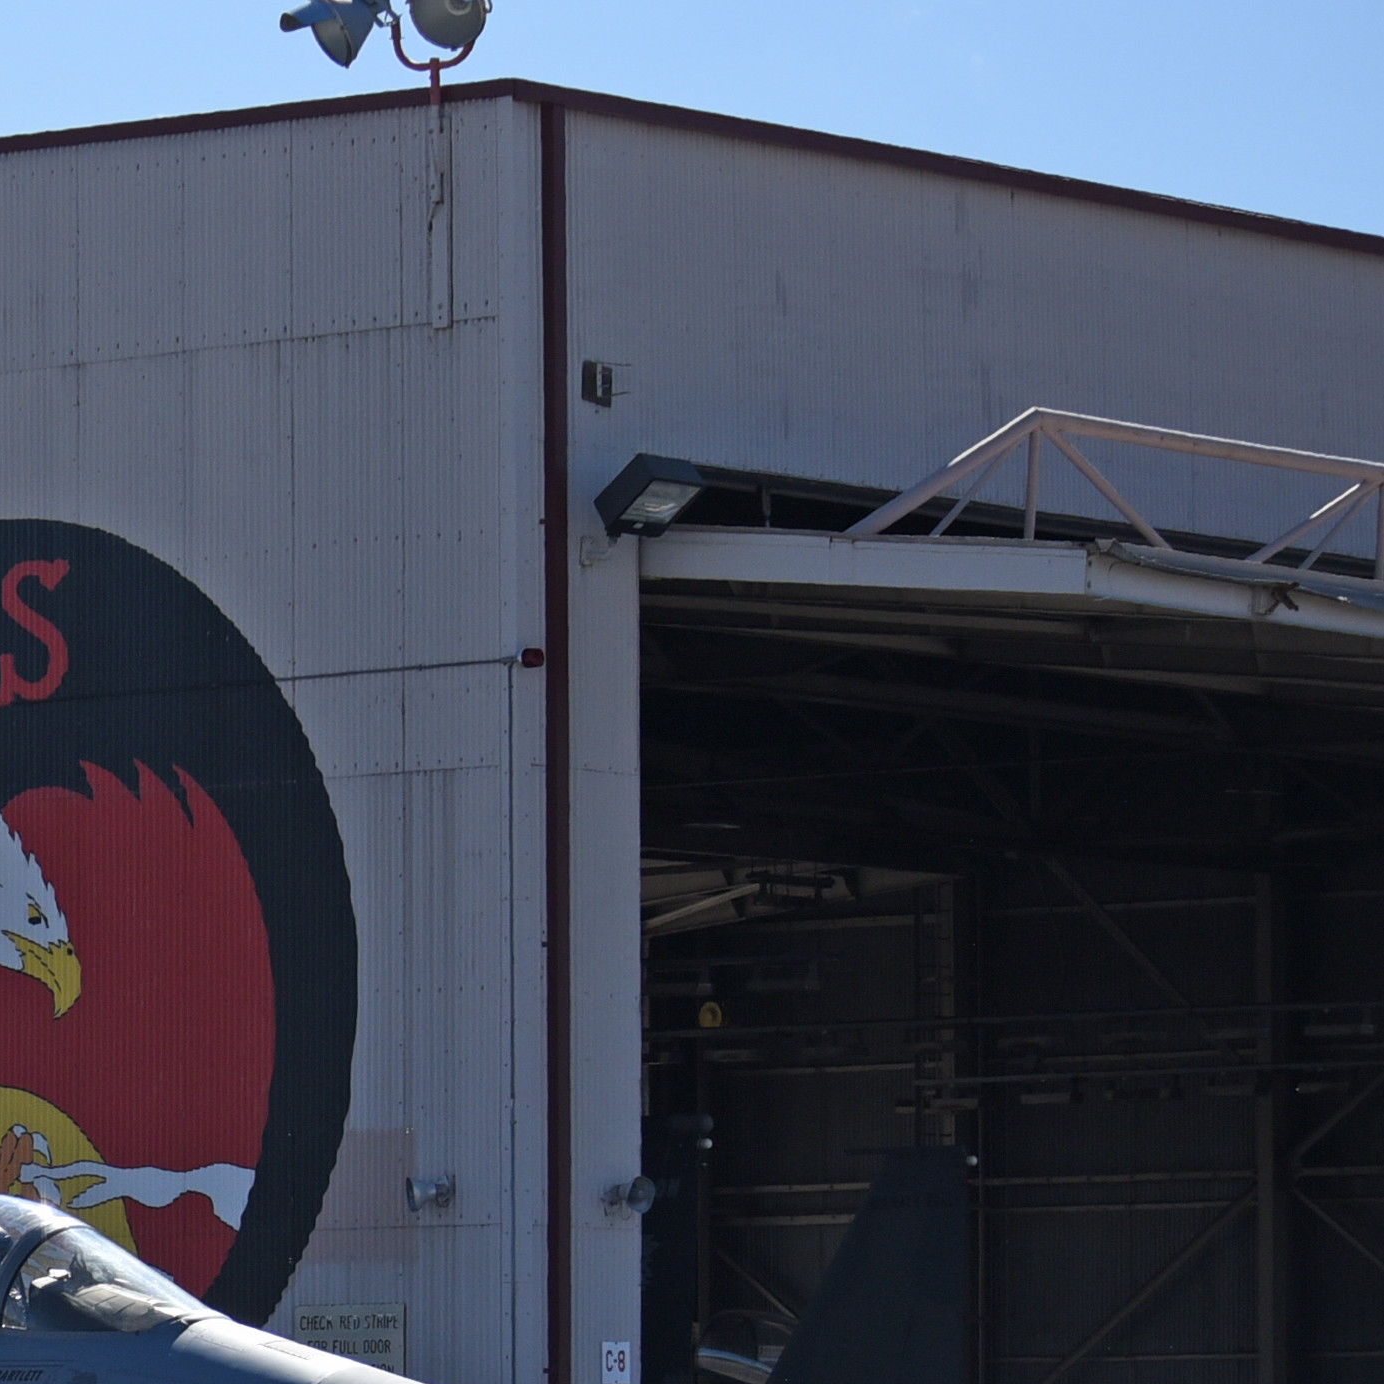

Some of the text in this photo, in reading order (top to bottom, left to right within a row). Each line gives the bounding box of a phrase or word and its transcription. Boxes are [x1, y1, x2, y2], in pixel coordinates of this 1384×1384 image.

[300, 1313, 398, 1331] CHECK RED STRIPE
[332, 1340, 358, 1355] FULL
[363, 1338, 391, 1354] DOOR
[606, 1350, 626, 1372] C-8
